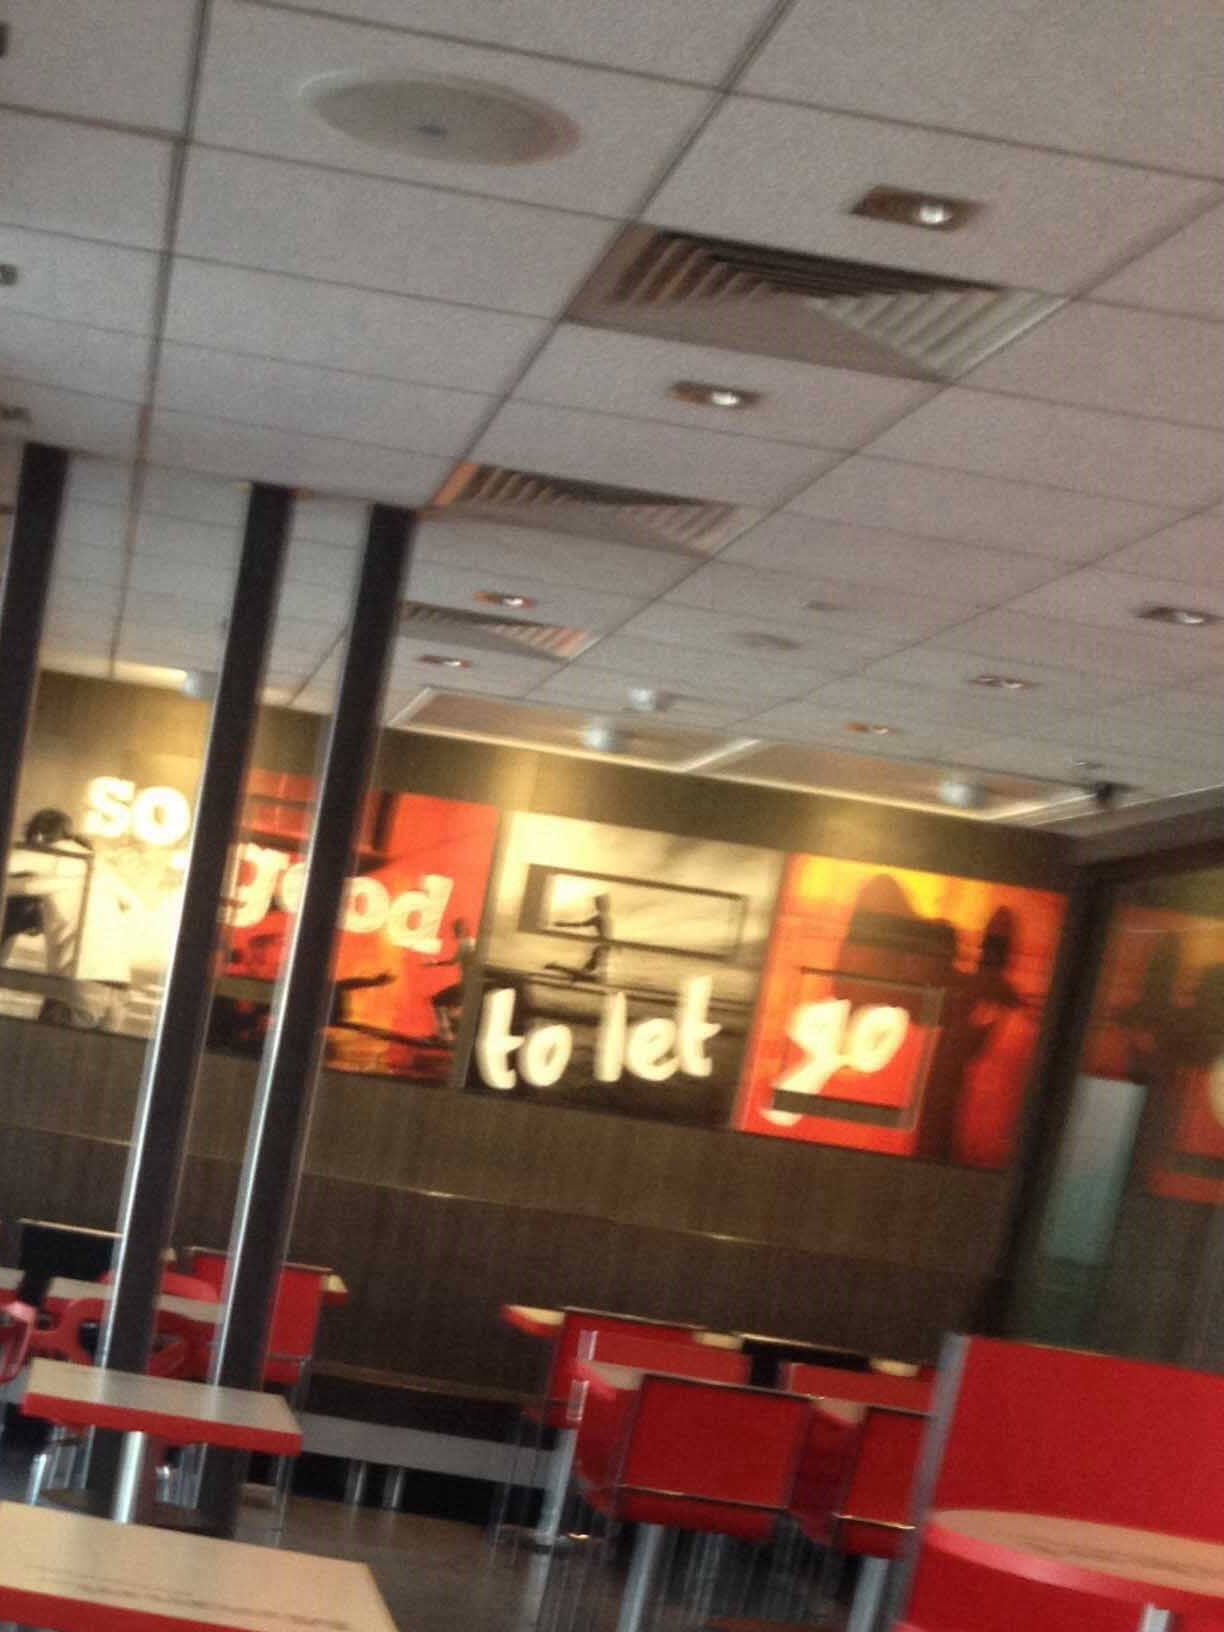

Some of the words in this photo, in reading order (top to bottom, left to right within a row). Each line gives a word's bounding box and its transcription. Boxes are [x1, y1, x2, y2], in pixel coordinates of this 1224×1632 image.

[84, 775, 190, 846] so
[477, 987, 573, 1090] to
[595, 974, 723, 1085] let
[760, 998, 910, 1126] go
